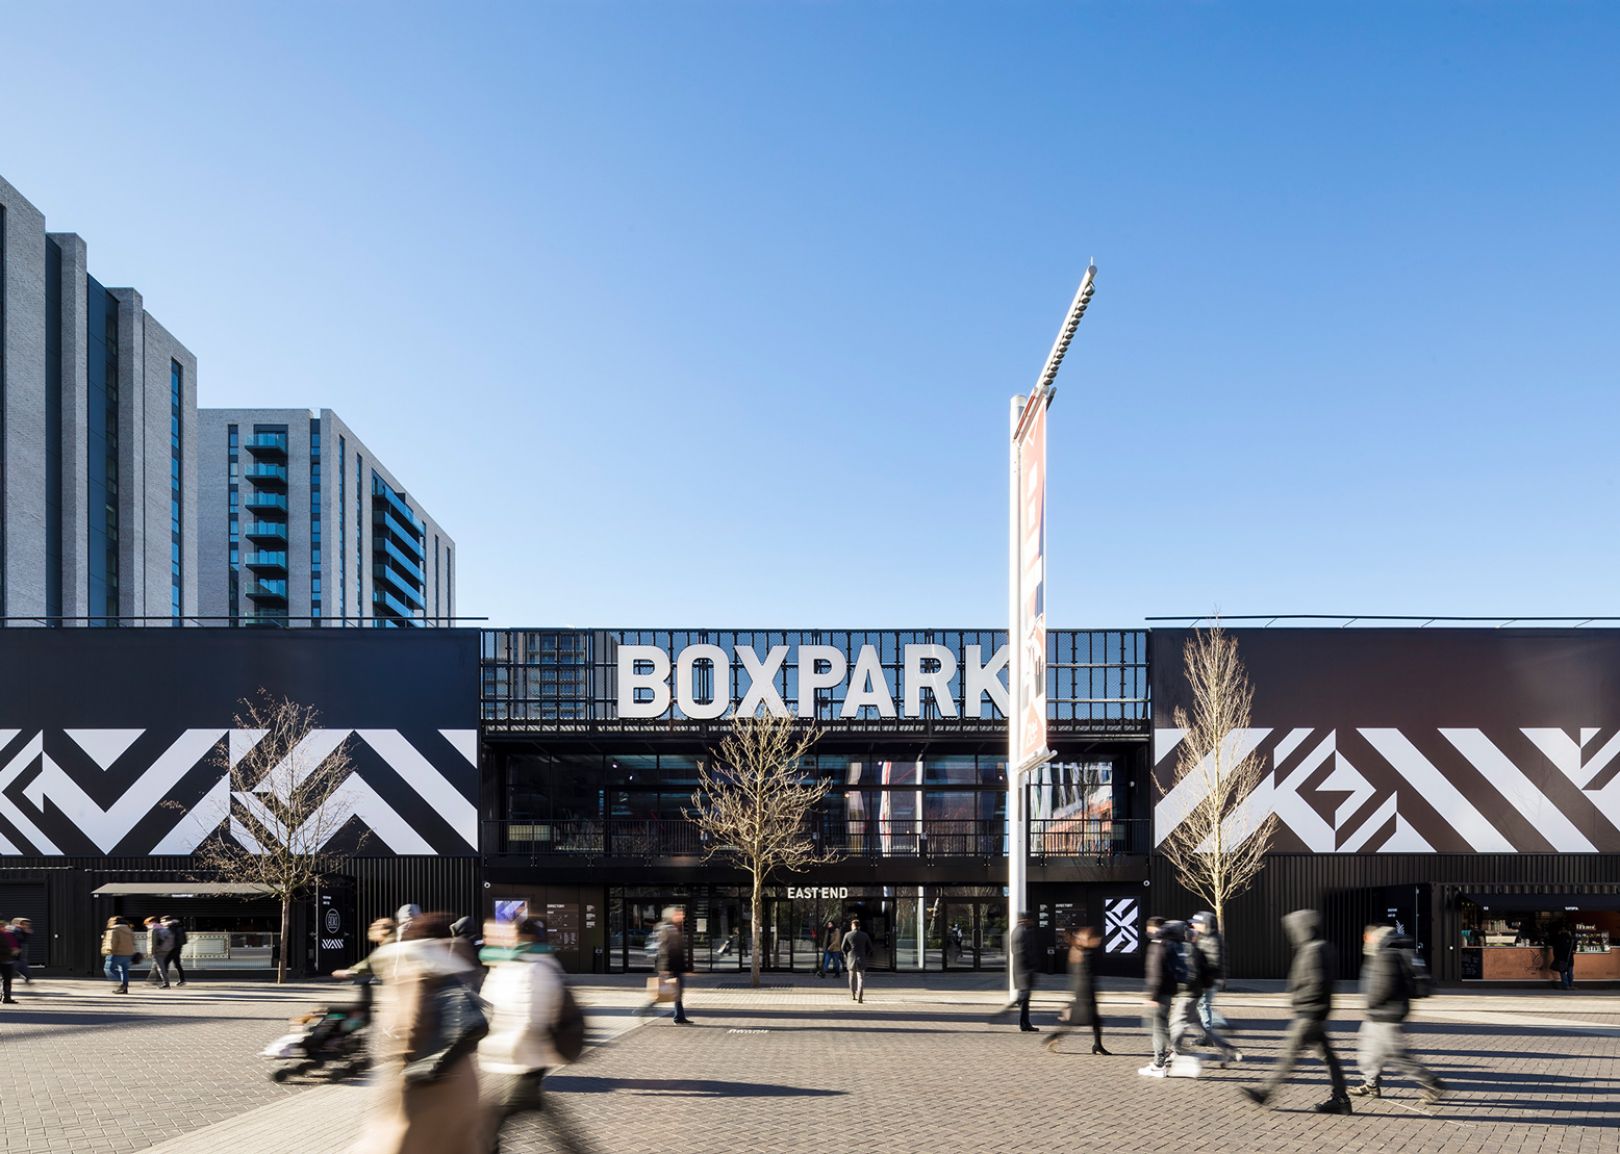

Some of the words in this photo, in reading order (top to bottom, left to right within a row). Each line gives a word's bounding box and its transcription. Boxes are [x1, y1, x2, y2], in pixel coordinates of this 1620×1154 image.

[617, 644, 1010, 719] BOXPARK
[787, 886, 819, 899] EAST
[821, 886, 849, 899] END
